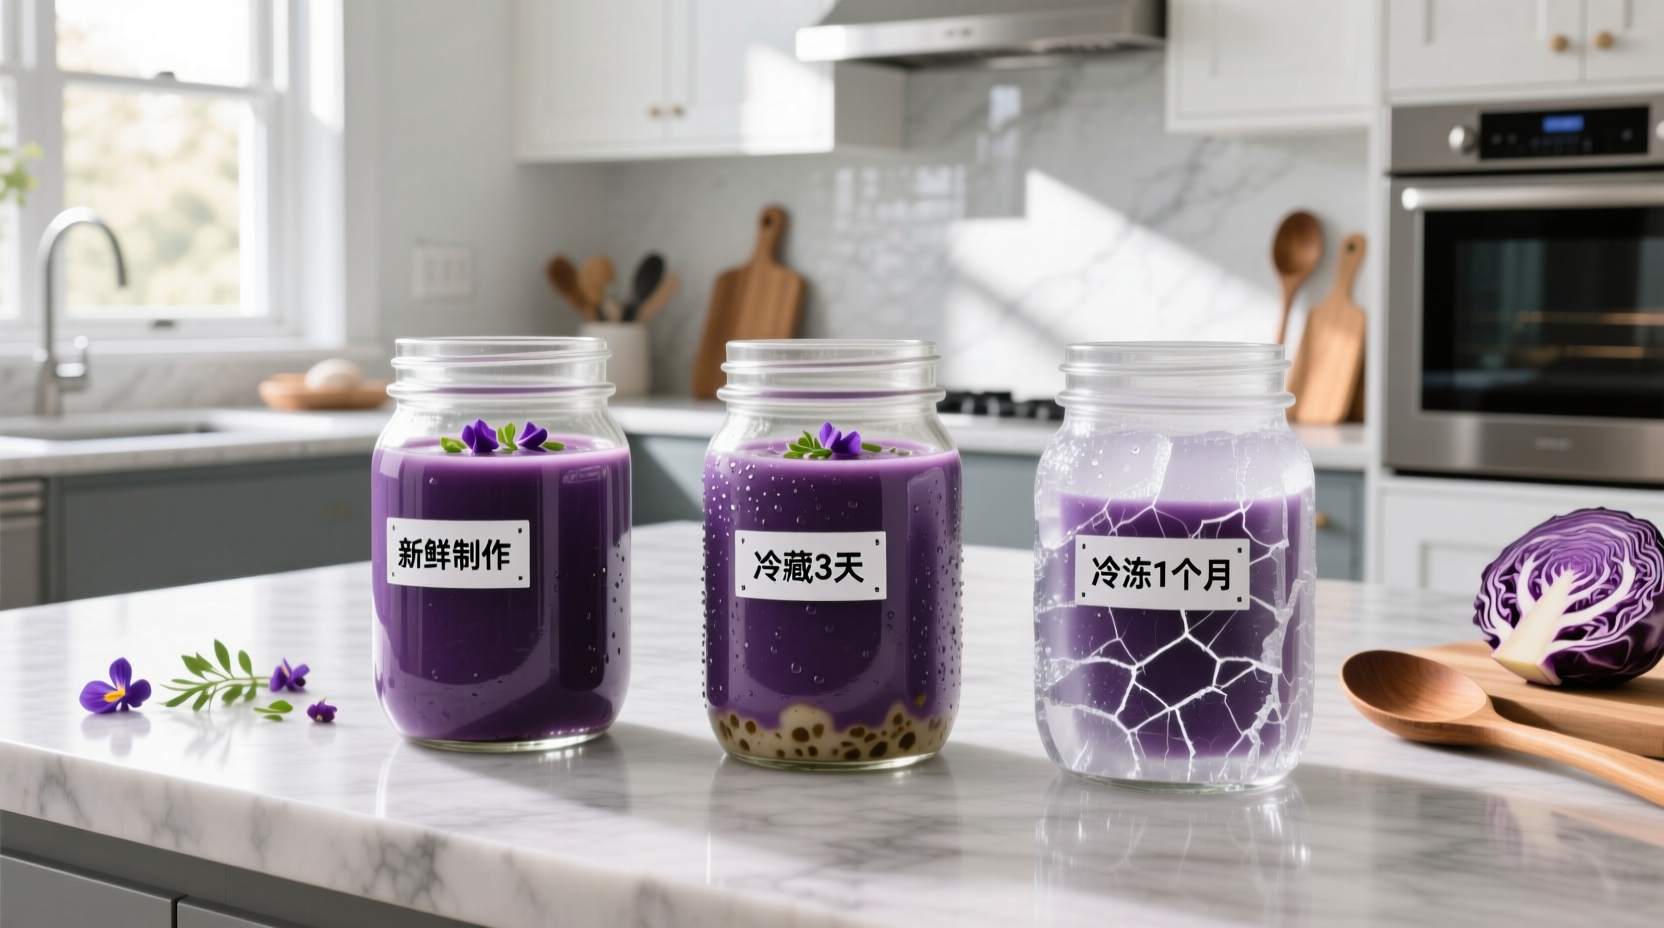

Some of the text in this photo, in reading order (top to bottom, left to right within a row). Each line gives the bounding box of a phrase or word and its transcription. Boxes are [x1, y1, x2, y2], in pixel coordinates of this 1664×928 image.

[398, 537, 511, 571] 新鲜制作
[753, 549, 864, 584] 冷藏3天
[1091, 555, 1231, 592] 冷冻1个月
